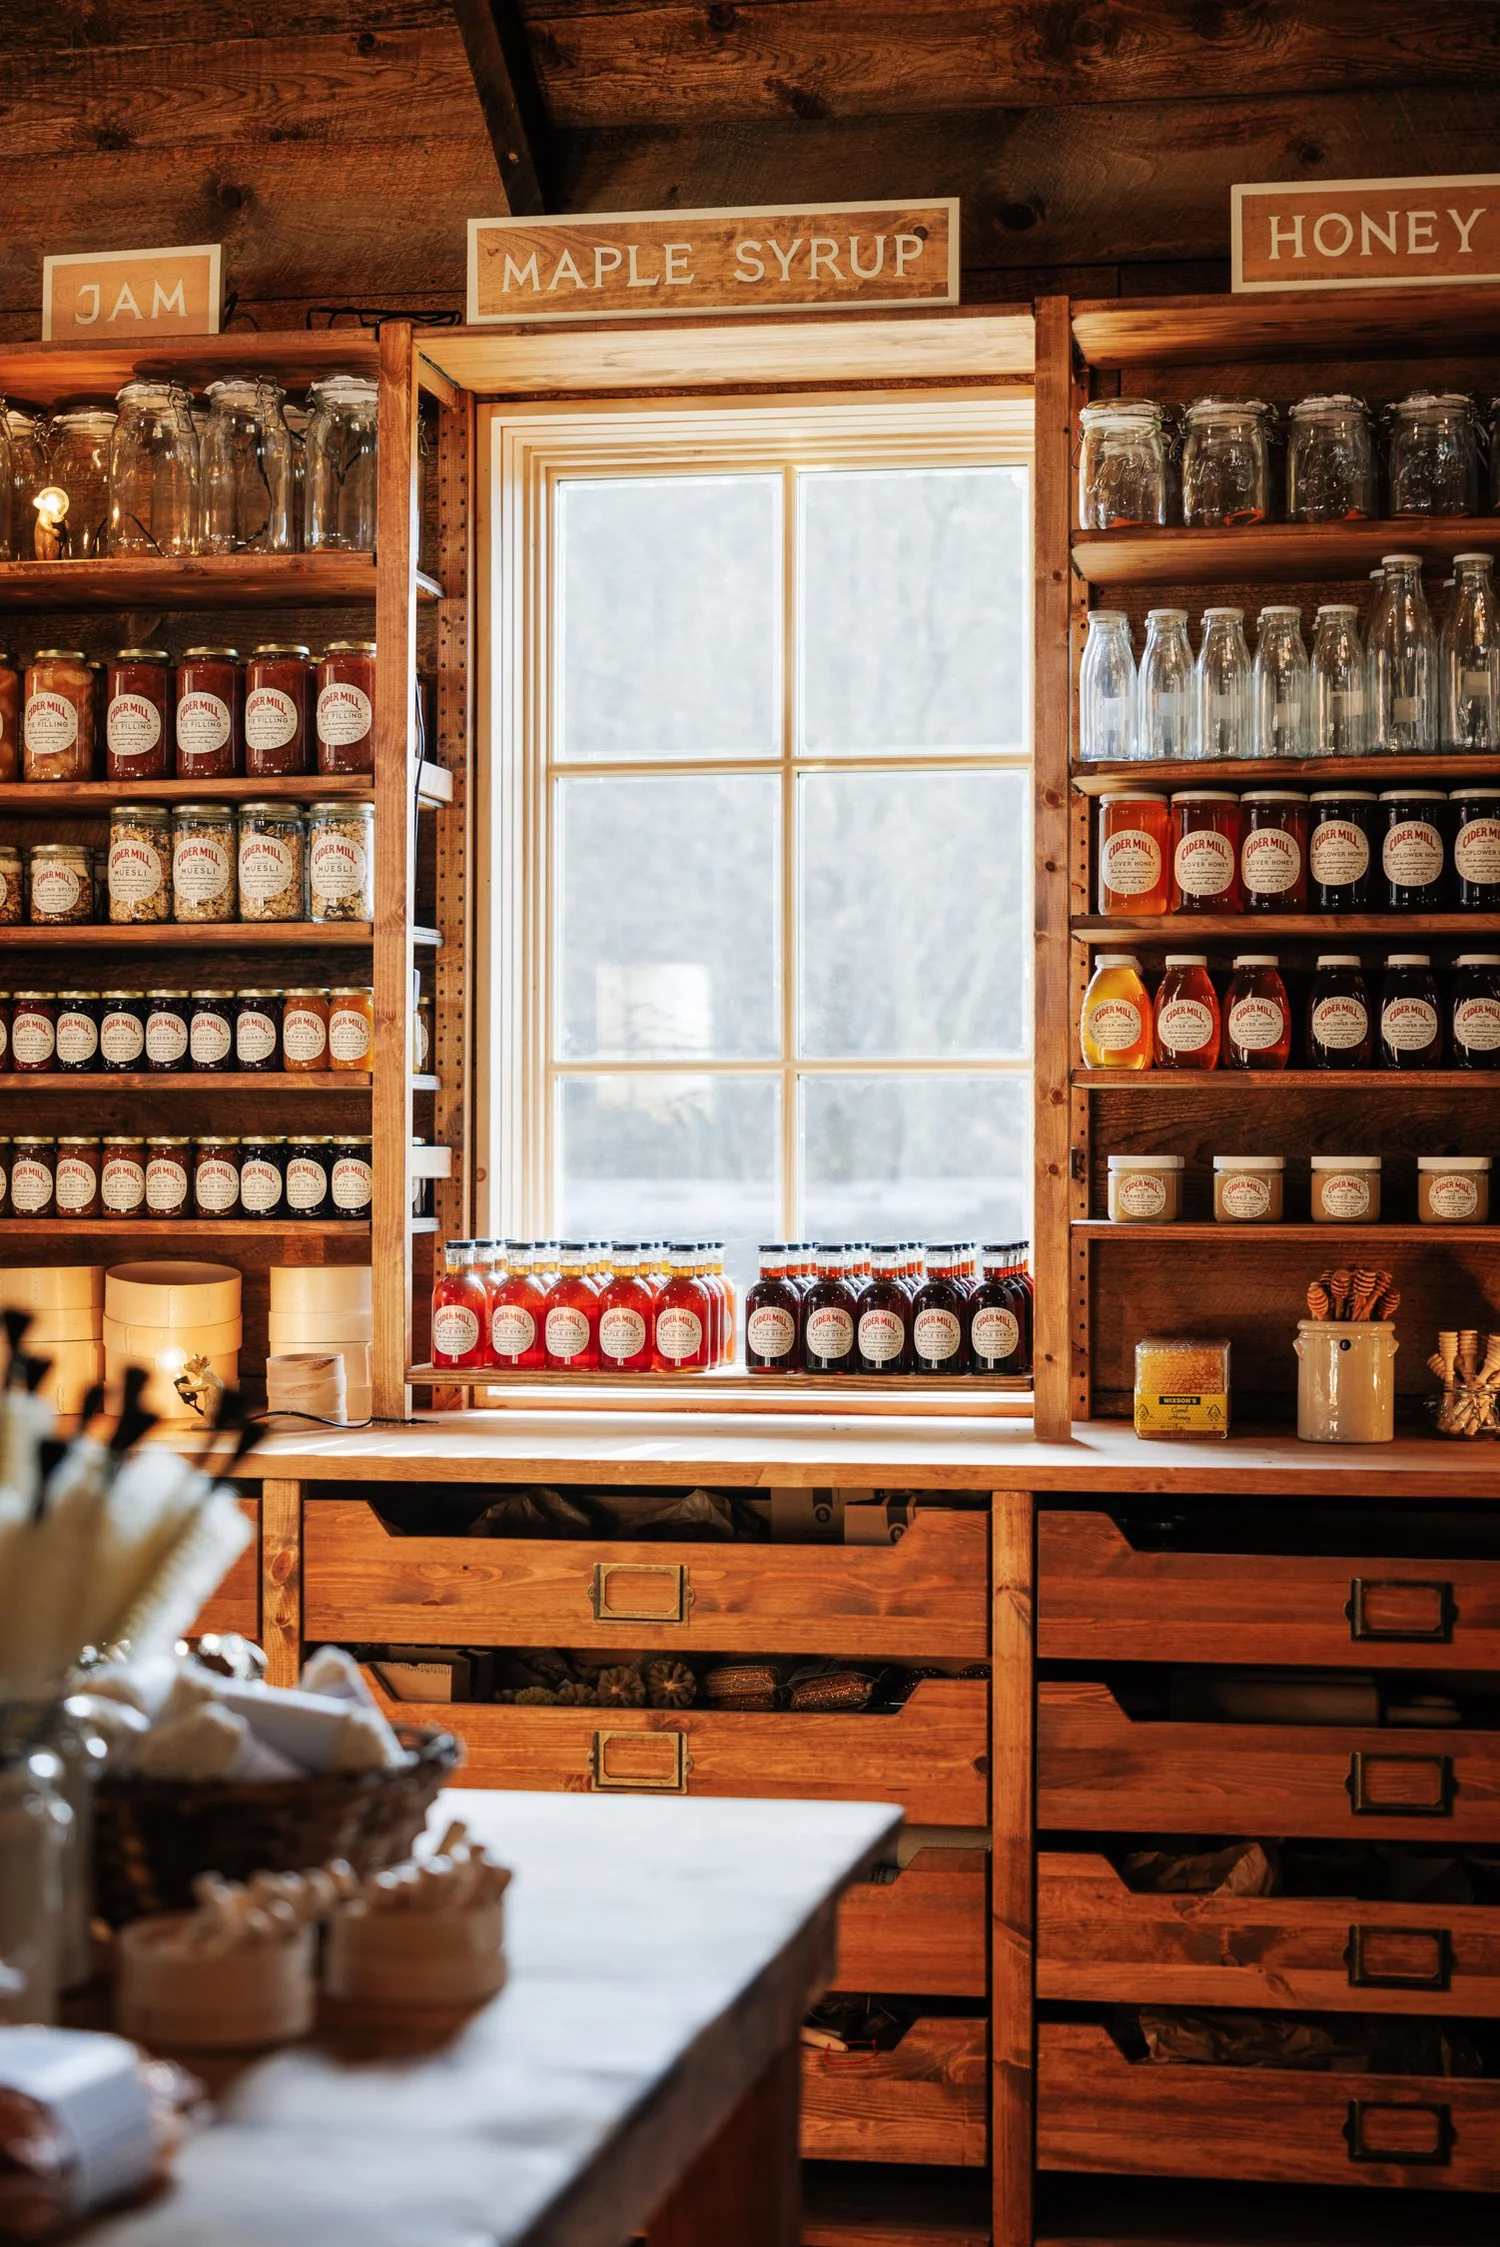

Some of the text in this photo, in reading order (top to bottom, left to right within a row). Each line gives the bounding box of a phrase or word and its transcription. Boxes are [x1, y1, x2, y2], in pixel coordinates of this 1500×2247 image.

[1268, 208, 1487, 259] HONEY
[501, 233, 927, 294] MAPLE SYRUP
[75, 277, 188, 326] JAM
[28, 701, 68, 721] CIDER MILL
[181, 701, 220, 720] CIDER MILL
[248, 696, 286, 717] CIDER MILL
[321, 692, 362, 713] CIDER MILL
[111, 702, 150, 723] CIDER MILL
[332, 712, 363, 720] FILLING
[1315, 829, 1360, 851] CIDER MILL
[1390, 830, 1436, 852] CIDER MILL
[1462, 827, 1488, 849] CIDER
[178, 847, 220, 866] CIDER MILL
[242, 844, 283, 864] CIDER MILL
[315, 844, 357, 864] CIDER MILL
[1109, 839, 1154, 860] CIDER MILL
[1182, 840, 1227, 861] CIDER MILL
[1247, 838, 1292, 859] CIDER MILL
[112, 849, 151, 868] CIDER MILL
[38, 871, 71, 886] CIDER MILL
[1095, 1006, 1134, 1022] CIDER MILL
[1166, 1007, 1204, 1023] CIDER MILL
[1236, 1004, 1275, 1022] CIDER MILL
[1321, 1004, 1359, 1021] CIDER MILL
[1390, 1006, 1428, 1022] CIDER MILL
[1463, 1006, 1484, 1022] CIDER
[122, 1020, 138, 1034] MILL
[1125, 1182, 1159, 1194] CIDER MILL
[1228, 1182, 1262, 1196] CIDER MILL
[1328, 1182, 1363, 1194] CIDER MILL
[1436, 1182, 1471, 1195] CIDER MILL
[437, 1312, 472, 1328] CIDER MILL
[495, 1312, 527, 1328] CIDER MILL
[549, 1314, 582, 1330] CIDER MILL
[604, 1315, 639, 1330] CIDER MILL
[660, 1315, 695, 1332] CIDER MILL
[754, 1313, 788, 1330] CIDER MILL
[812, 1314, 848, 1330] CIDER MILL
[862, 1316, 897, 1333] CIDER MILL
[918, 1316, 953, 1332] CIDER MILL
[976, 1314, 1012, 1331] CIDER MILL
